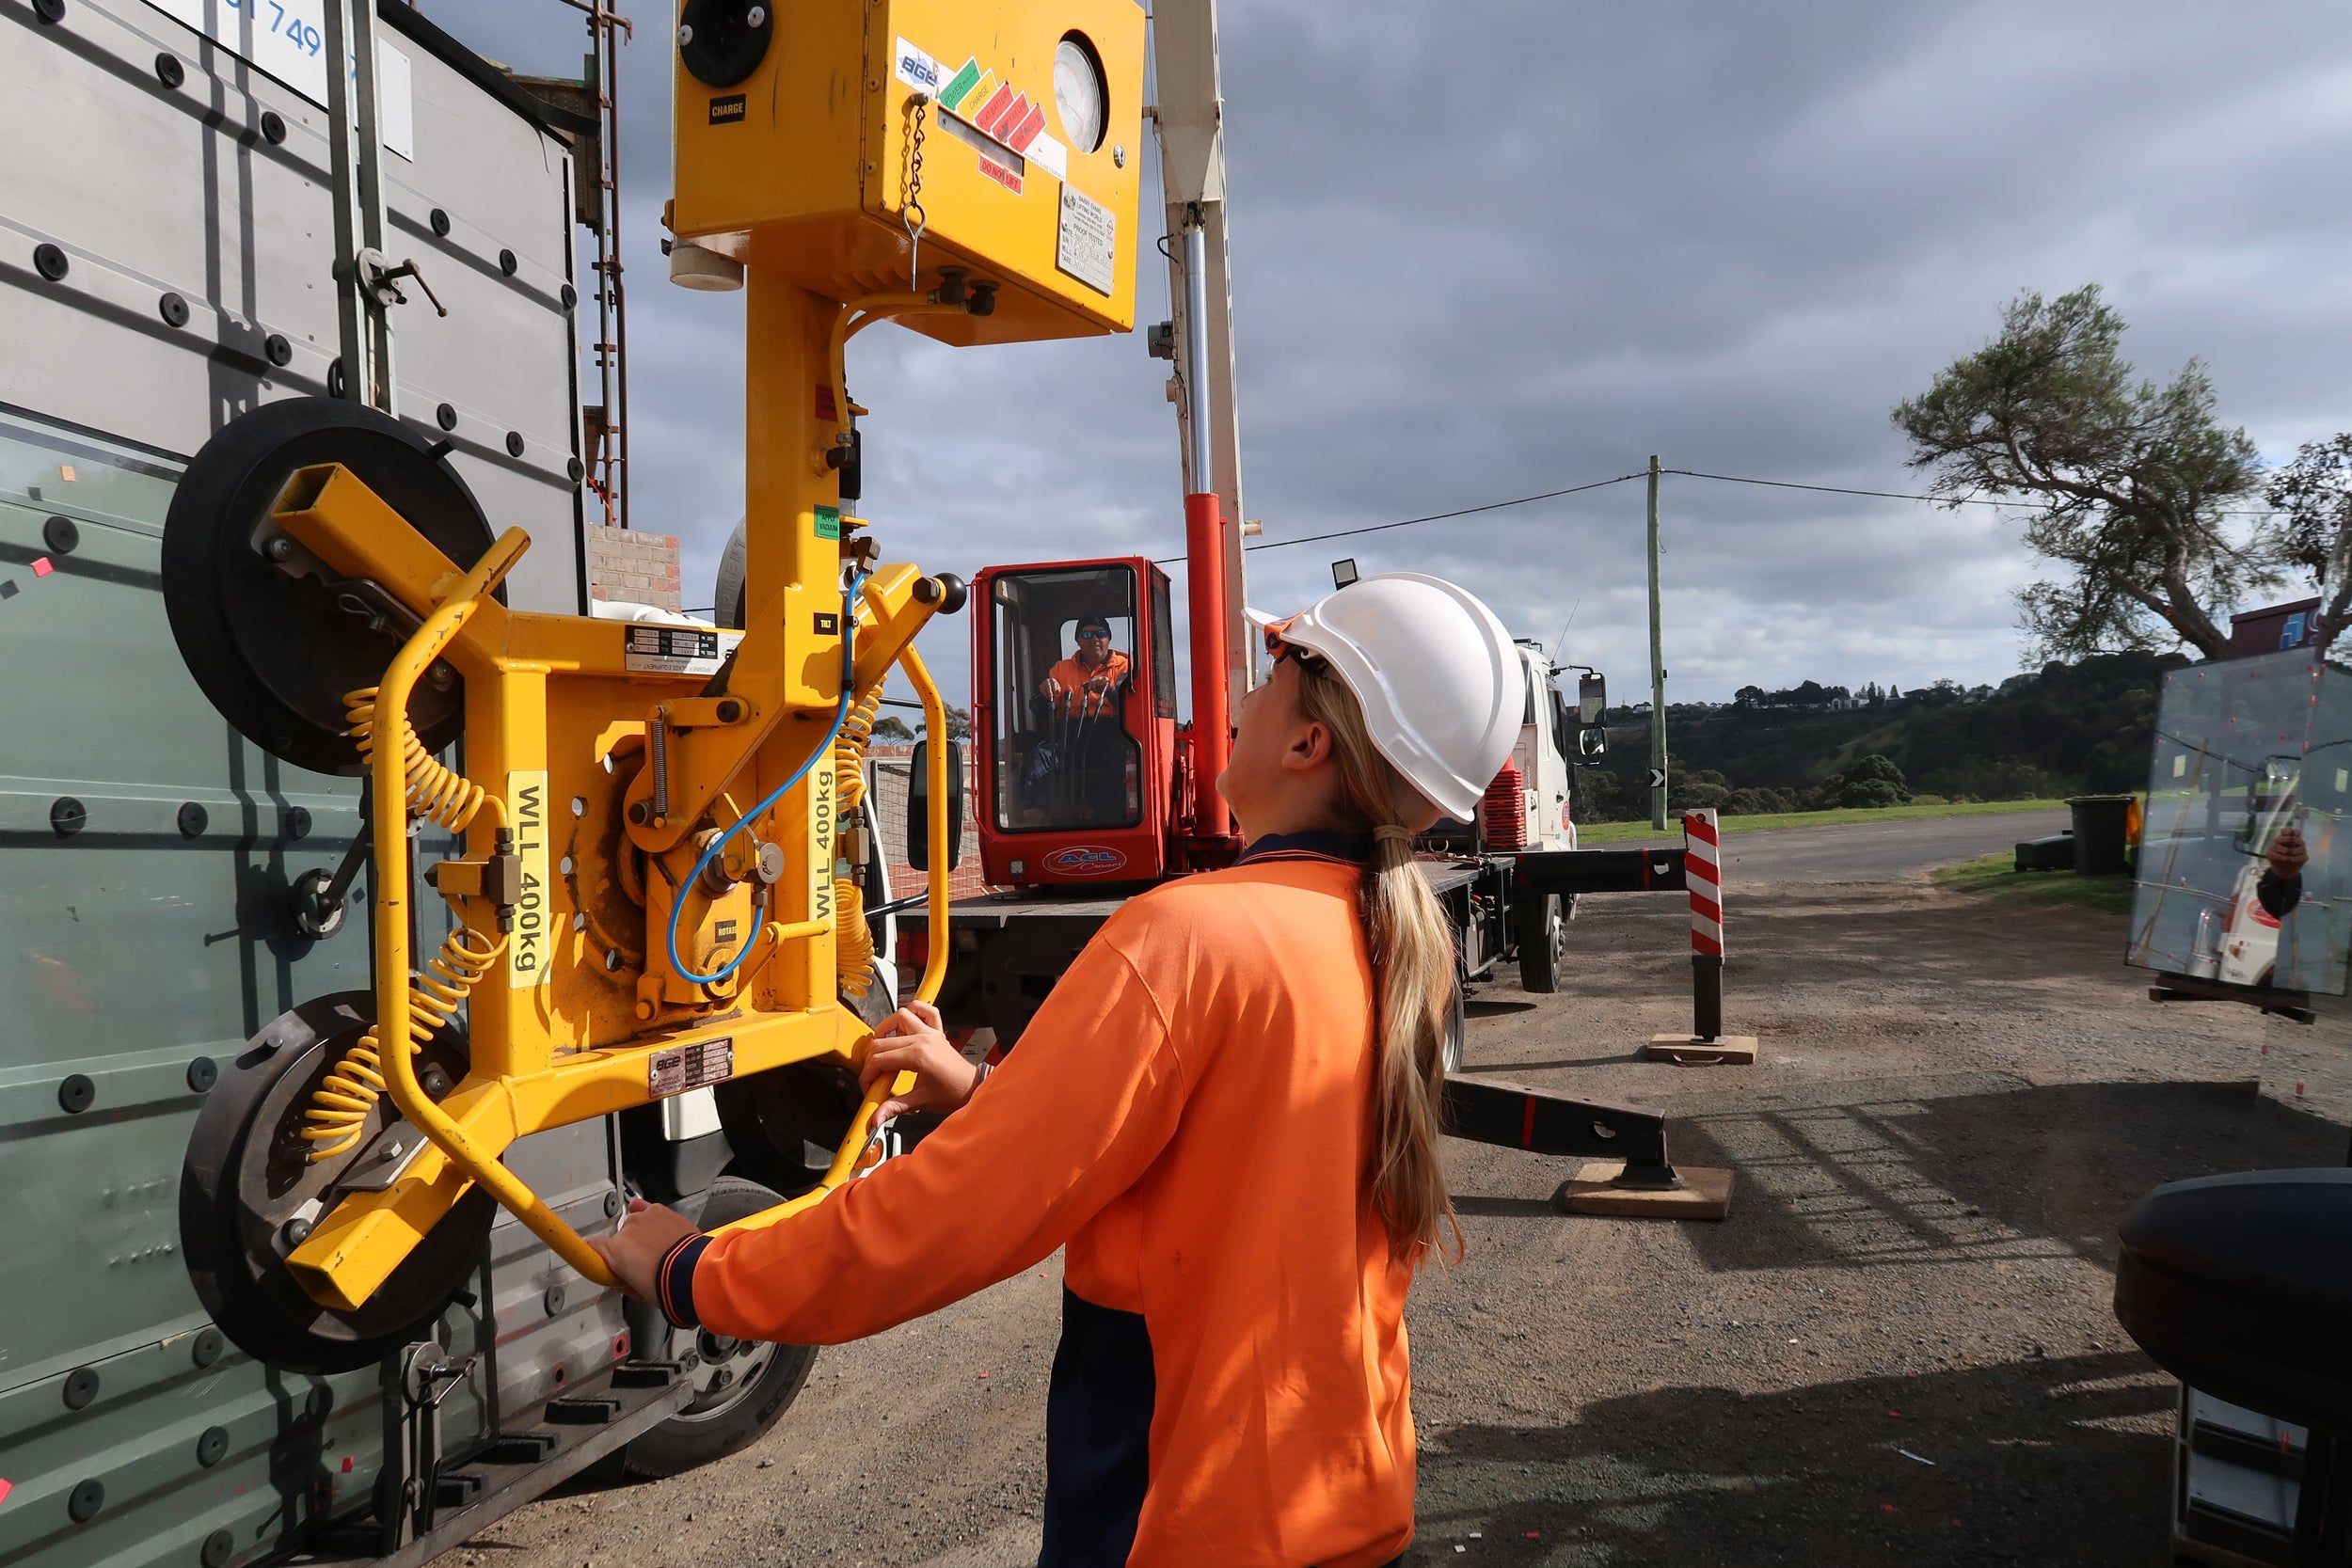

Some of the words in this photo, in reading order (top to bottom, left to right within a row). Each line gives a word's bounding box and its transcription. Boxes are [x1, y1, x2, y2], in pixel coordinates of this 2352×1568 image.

[944, 82, 964, 105] POWER
[969, 85, 990, 110] CHARGE
[990, 90, 1011, 116] BATTERY
[712, 103, 743, 117] CHARGE
[982, 161, 992, 173] DO
[1006, 175, 1019, 189] LIFT
[1089, 231, 1104, 246] TESTED
[819, 522, 838, 532] VACUUM
[821, 513, 835, 522] APPLY
[819, 619, 833, 628] TILT
[817, 771, 834, 849] 400kg
[518, 785, 540, 863] WLL
[1057, 851, 1117, 863] ACL
[817, 857, 831, 920] WLL
[515, 872, 541, 973] 400kg
[718, 927, 738, 937] ROTATE
